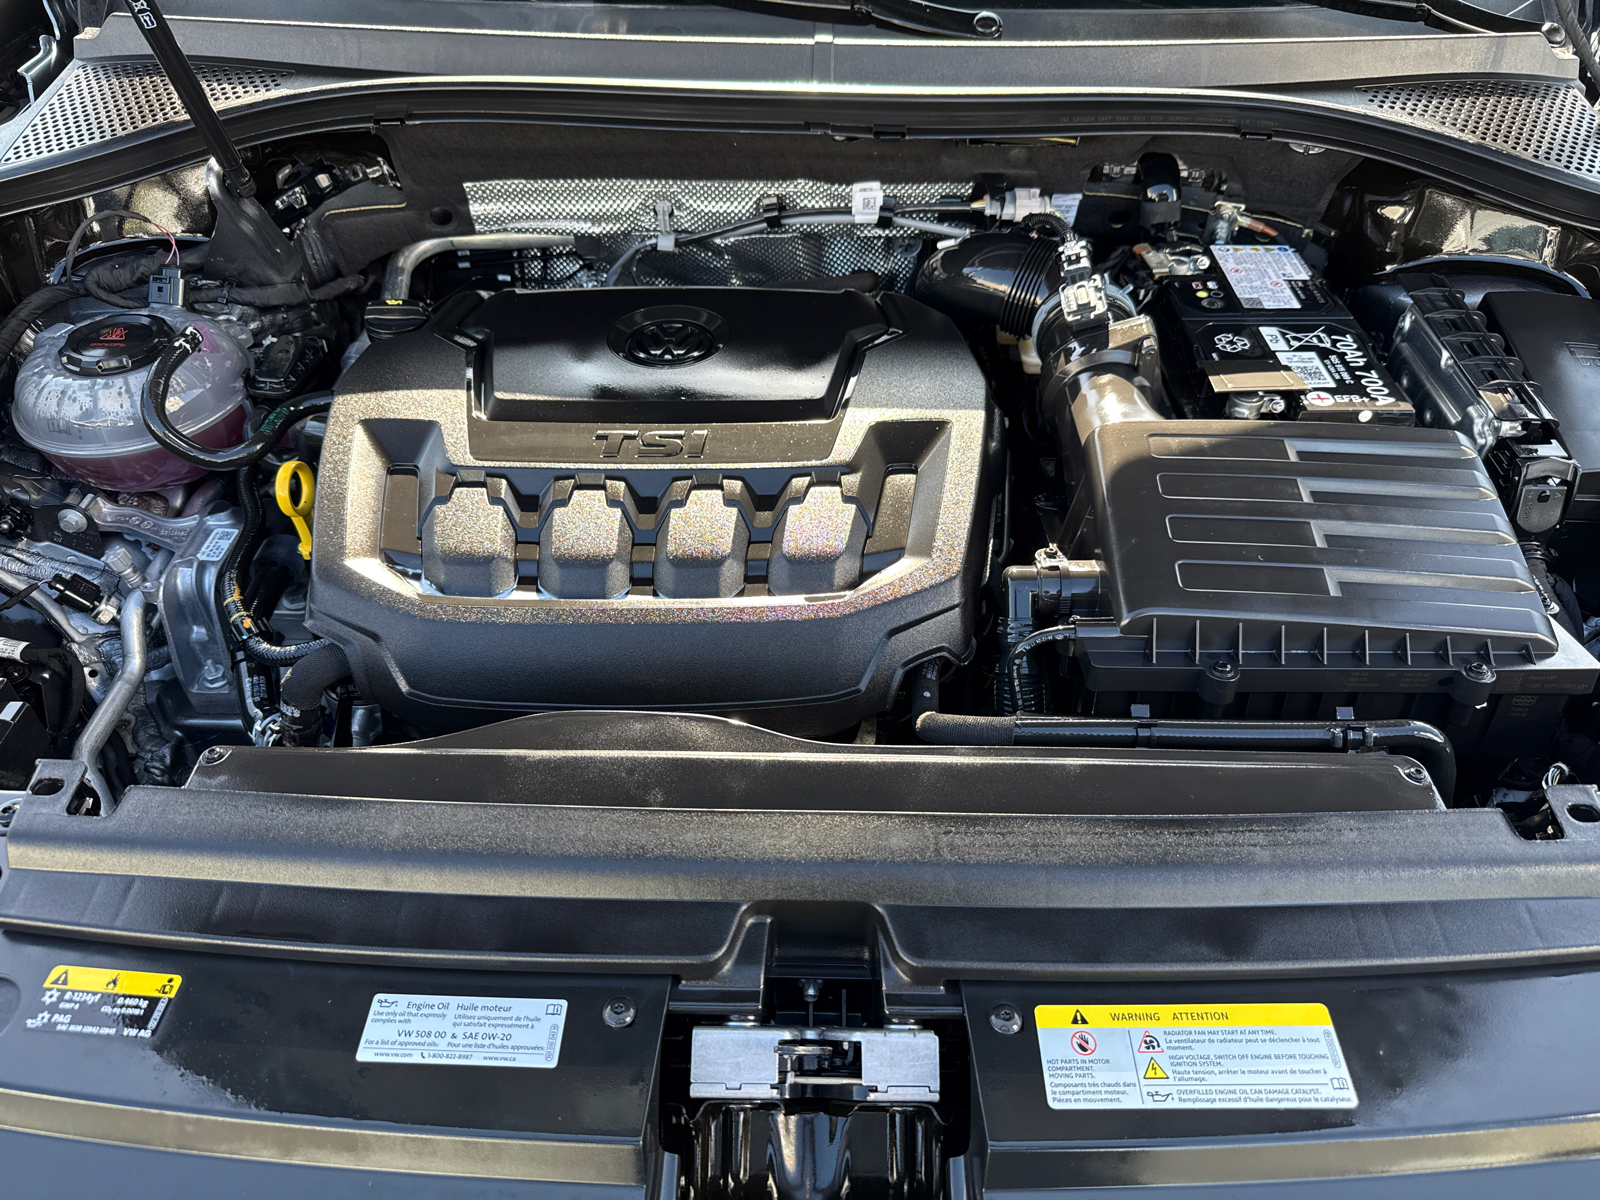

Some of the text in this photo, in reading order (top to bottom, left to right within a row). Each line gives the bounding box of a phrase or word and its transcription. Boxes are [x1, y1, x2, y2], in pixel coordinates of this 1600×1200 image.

[1266, 334, 1281, 344] Pb
[1330, 334, 1396, 406] 70Ah 700A
[593, 430, 709, 458] TSI
[137, 998, 149, 1009] kg
[406, 1001, 450, 1011] Engine Oil
[456, 1003, 512, 1012] Huile moteur
[51, 1014, 72, 1024] PAG
[1109, 1012, 1229, 1021] WARNING ATTENTION
[123, 1028, 152, 1038] VW AG
[397, 1029, 414, 1038] VW
[414, 1030, 432, 1038] 508
[433, 1030, 447, 1038] 00
[462, 1031, 480, 1040] SAE
[481, 1032, 512, 1041] 0W-20
[487, 1042, 509, 1050] d'huiles
[427, 1052, 473, 1060] 1-800-822-8987
[1050, 1081, 1087, 1089] Composants
[1178, 1096, 1216, 1104] Remplissage
[1264, 1096, 1297, 1104] dangereux
